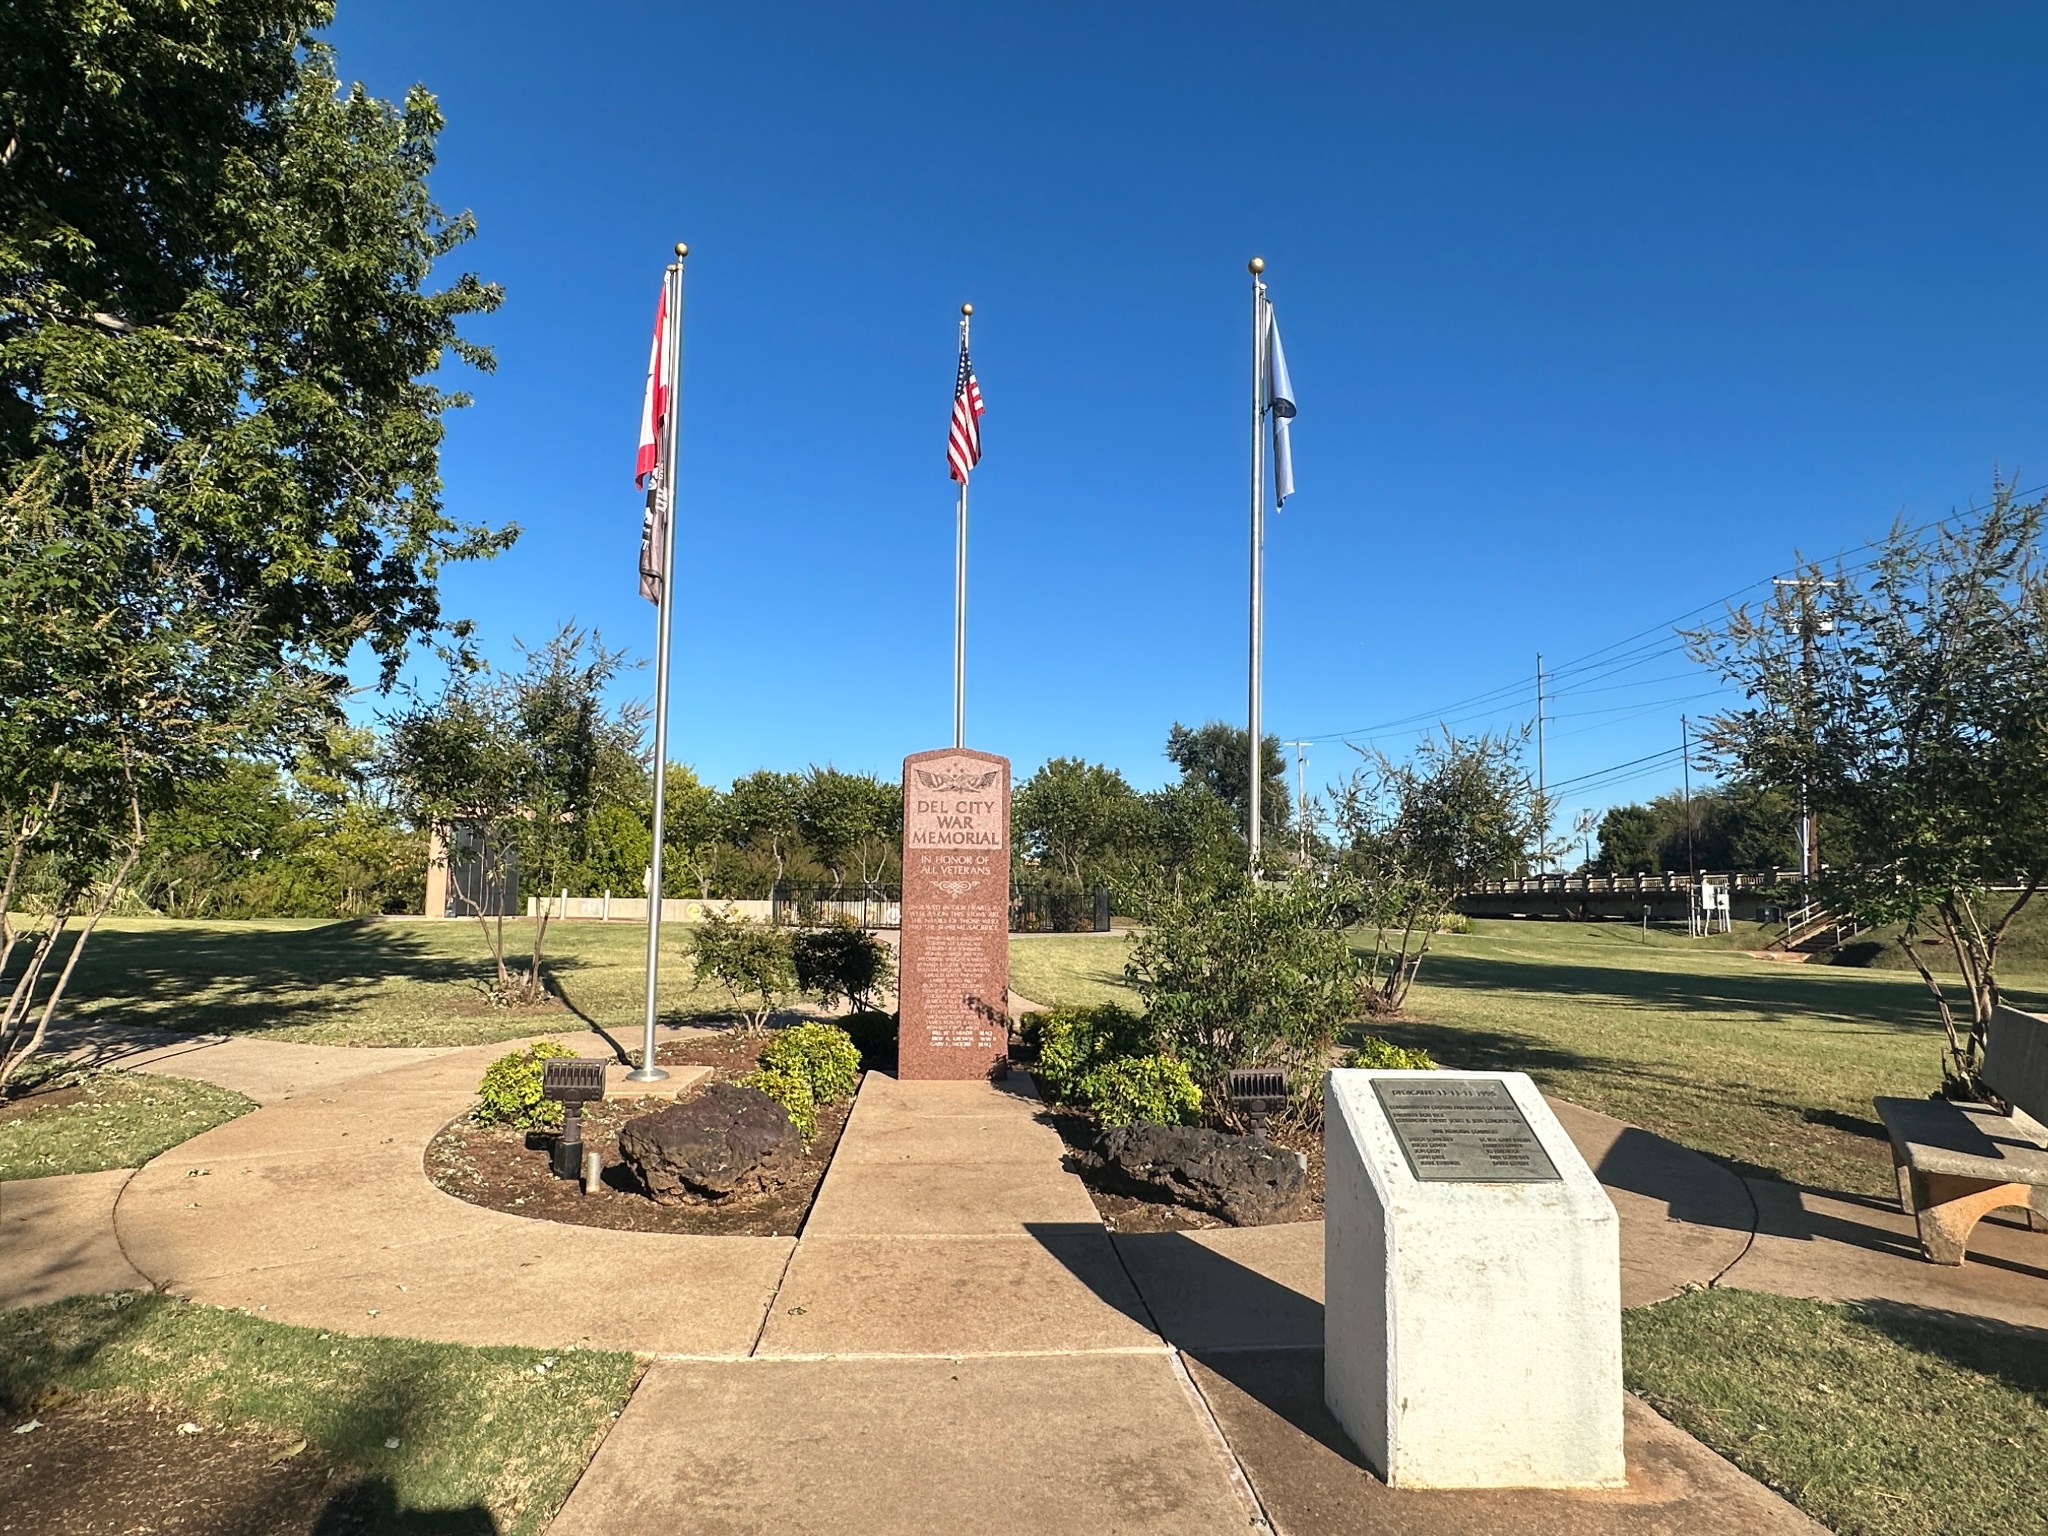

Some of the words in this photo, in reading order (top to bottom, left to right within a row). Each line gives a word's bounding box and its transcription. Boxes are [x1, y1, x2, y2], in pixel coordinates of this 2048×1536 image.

[917, 800, 948, 814] DEL
[955, 800, 995, 814] CITY
[936, 815, 974, 829] WAR
[912, 831, 999, 845] MEMORIAL
[921, 855, 932, 864] IN
[935, 855, 973, 864] HONOR
[976, 855, 990, 864] OF
[920, 865, 936, 874] ALL
[941, 865, 991, 875] VETERANS
